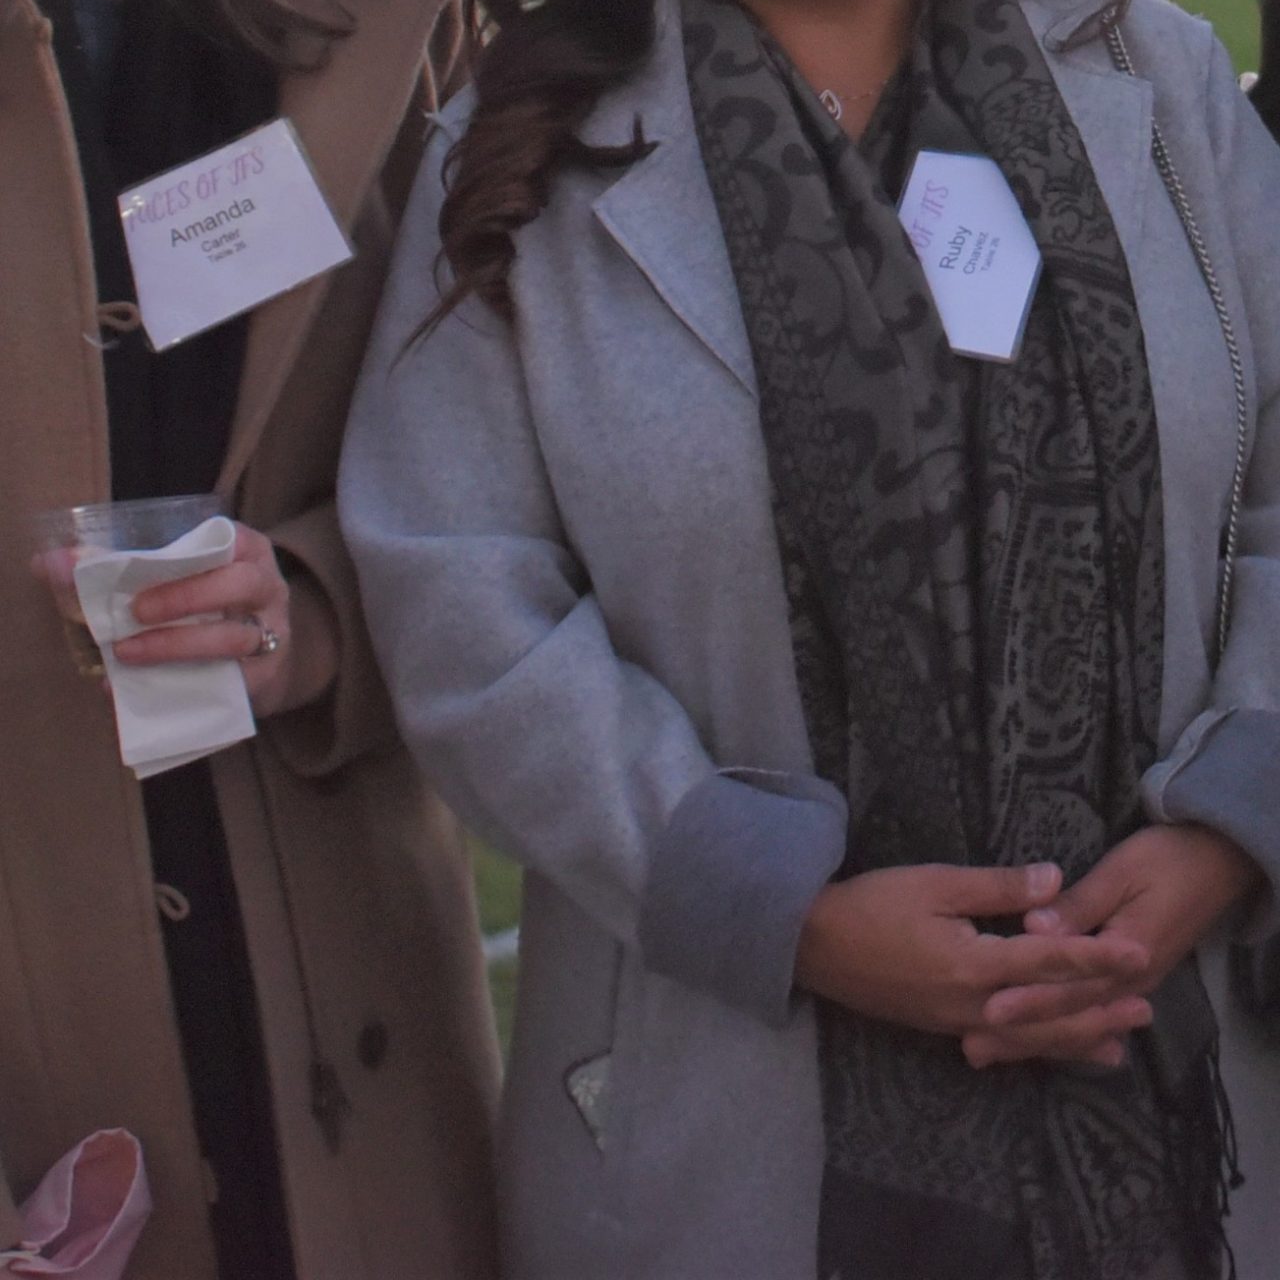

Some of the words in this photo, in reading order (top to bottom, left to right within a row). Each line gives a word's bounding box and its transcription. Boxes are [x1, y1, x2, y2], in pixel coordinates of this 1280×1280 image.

[196, 167, 222, 200] OF
[229, 145, 265, 186] JFS
[169, 197, 256, 248] Amanda
[201, 228, 240, 253] Carter
[939, 225, 972, 270] Ruby
[963, 231, 990, 275] Chavez
